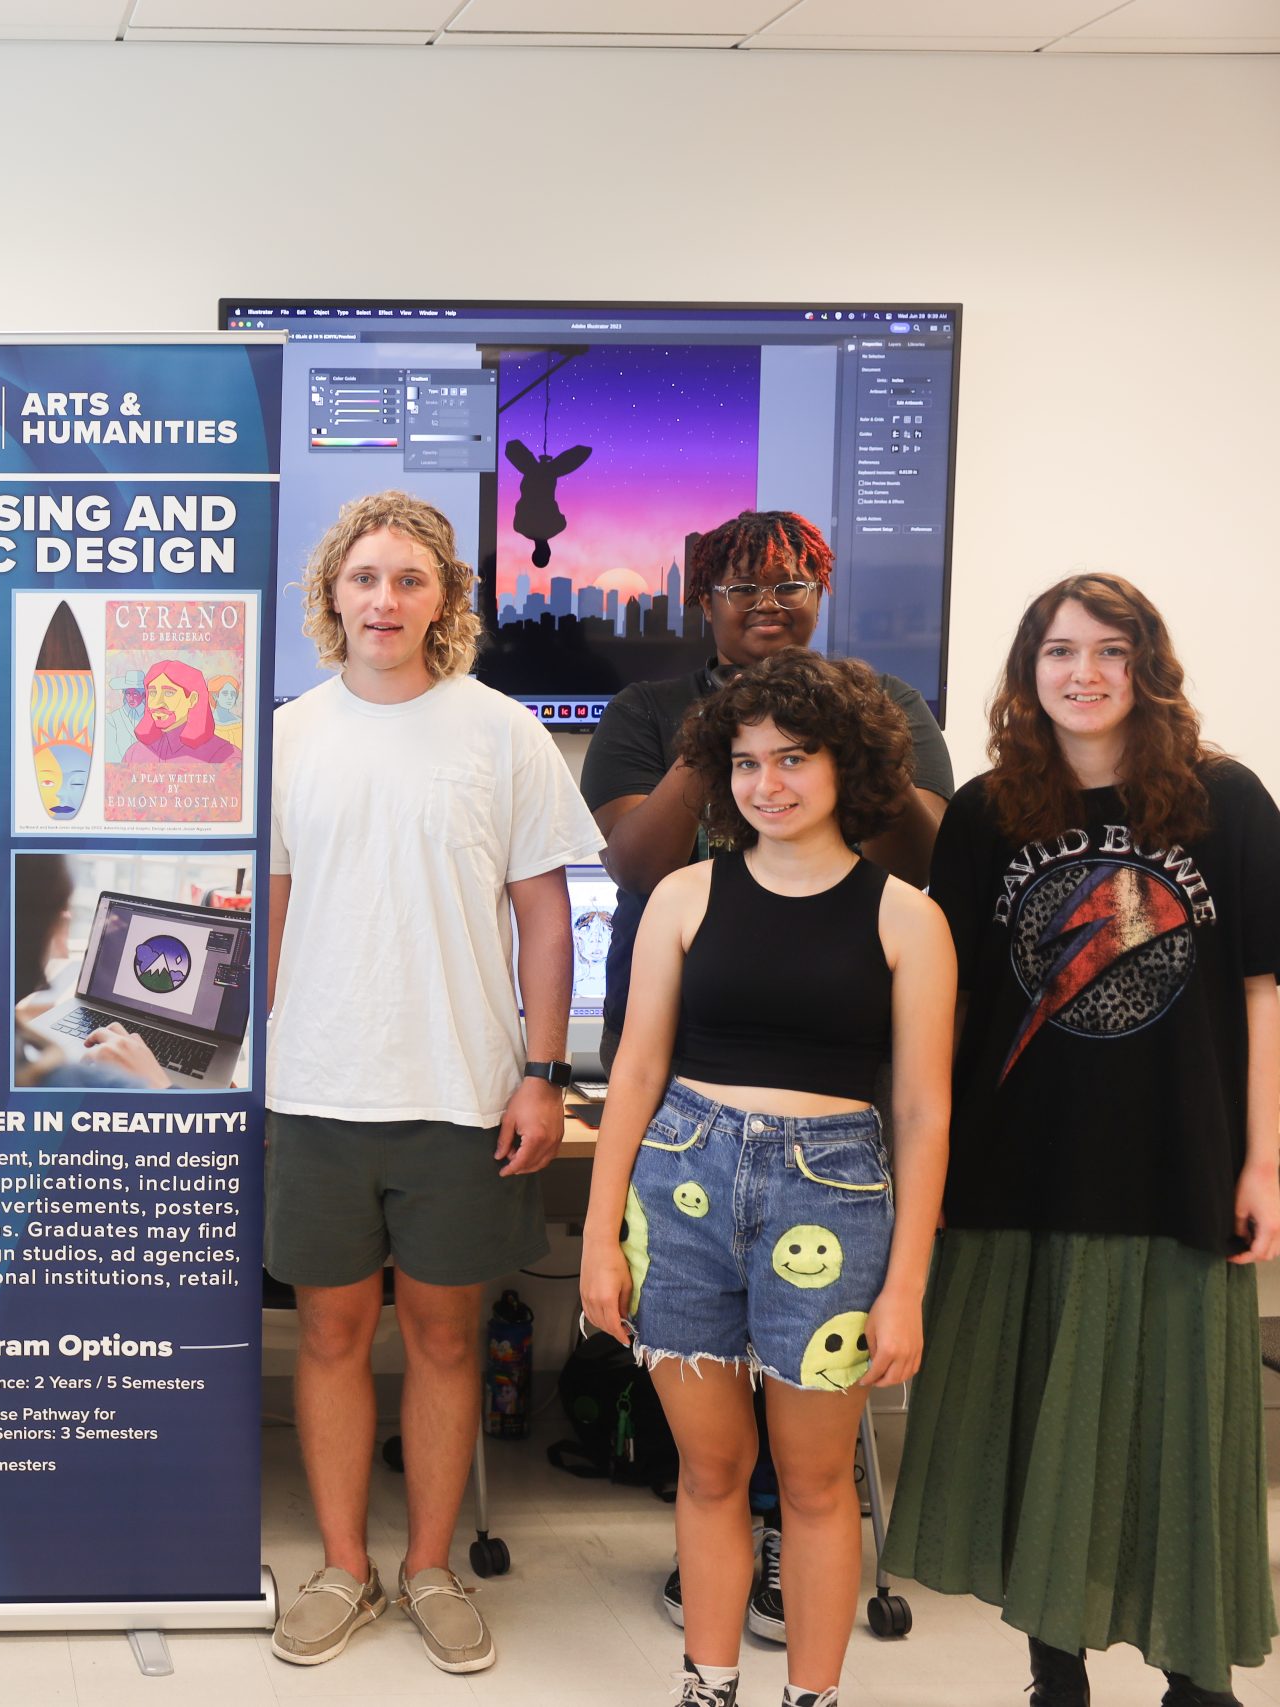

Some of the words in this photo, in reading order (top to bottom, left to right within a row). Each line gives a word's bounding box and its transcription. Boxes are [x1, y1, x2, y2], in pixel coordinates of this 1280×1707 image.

[336, 309, 349, 317] Type
[20, 391, 110, 417] ARTS
[119, 391, 142, 416] &
[22, 419, 238, 445] HUMANITIES
[123, 495, 237, 532] AND
[36, 536, 235, 574] DESIGN
[115, 605, 238, 629] CYRANO
[142, 632, 155, 641] DE
[159, 632, 211, 641] BERGERAC
[131, 774, 137, 783] A
[141, 774, 165, 783] PLAY
[168, 774, 216, 784] WRITTEN
[167, 784, 179, 794] BY
[107, 796, 168, 808] EDMOND
[174, 796, 239, 808] ROSTAND
[992, 827, 1089, 928] DAVID
[33, 1111, 63, 1132] IN
[71, 1111, 247, 1134] CREATIVITY!
[38, 1149, 129, 1171] branding,
[134, 1151, 171, 1168] and
[176, 1150, 239, 1171] design
[139, 1174, 240, 1194] including
[155, 1200, 239, 1219] posters,
[27, 1221, 139, 1239] Graduates
[147, 1226, 191, 1243] may
[197, 1221, 236, 1239] find
[22, 1244, 103, 1264] studios,
[110, 1246, 135, 1262] ad
[143, 1246, 240, 1266] agencies,
[45, 1268, 171, 1289] institutions,
[179, 1269, 239, 1287] retail,
[58, 1332, 173, 1362] Options
[34, 1375, 45, 1389] 2
[48, 1375, 92, 1389] Years
[95, 1375, 103, 1389] /
[107, 1375, 117, 1389] 5
[121, 1375, 205, 1390] Semesters
[23, 1407, 90, 1424] Pathway
[93, 1407, 116, 1421] for
[60, 1426, 71, 1440] 3
[75, 1426, 158, 1440] Semesters
